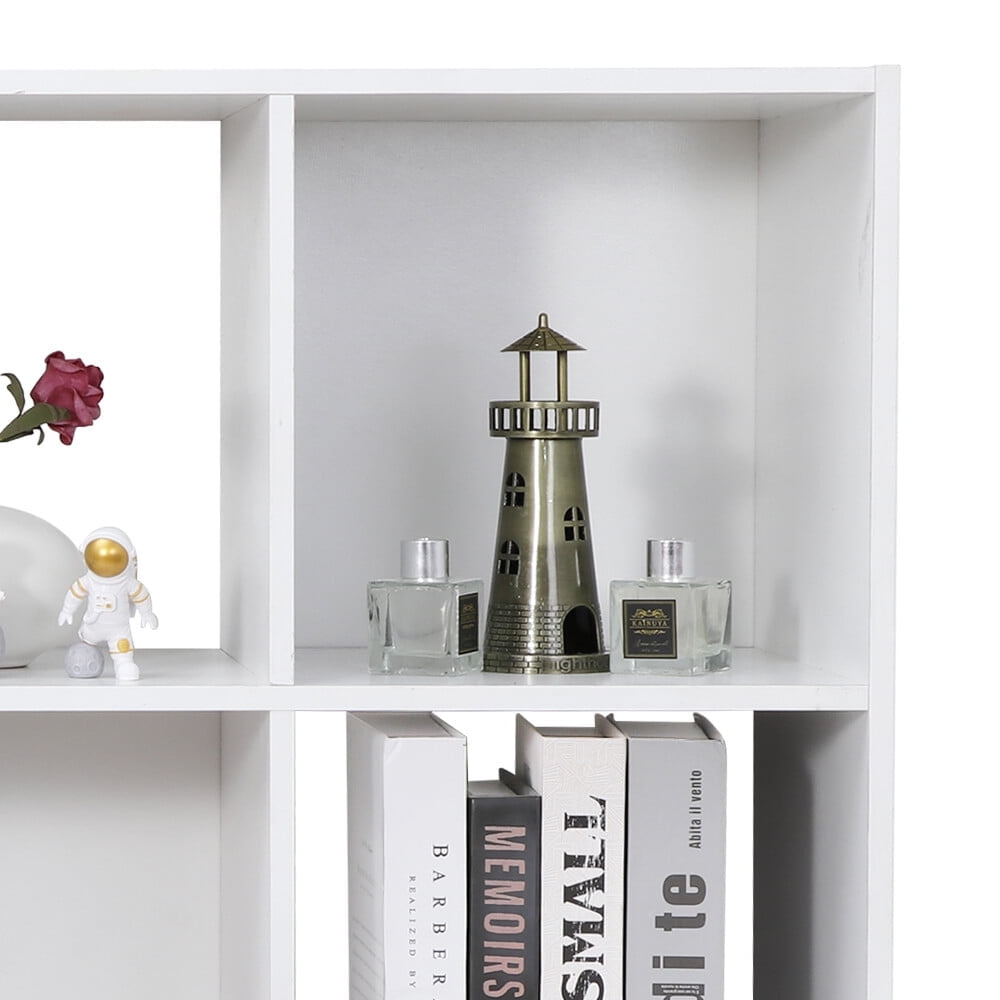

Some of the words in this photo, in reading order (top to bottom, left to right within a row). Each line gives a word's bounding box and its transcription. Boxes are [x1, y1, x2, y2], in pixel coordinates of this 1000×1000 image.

[689, 769, 702, 802] vento
[689, 819, 703, 849] Abita
[408, 875, 418, 958] REALIZED
[482, 824, 526, 998] MEMOIRS
[654, 874, 707, 932] te
[408, 970, 418, 989] BY
